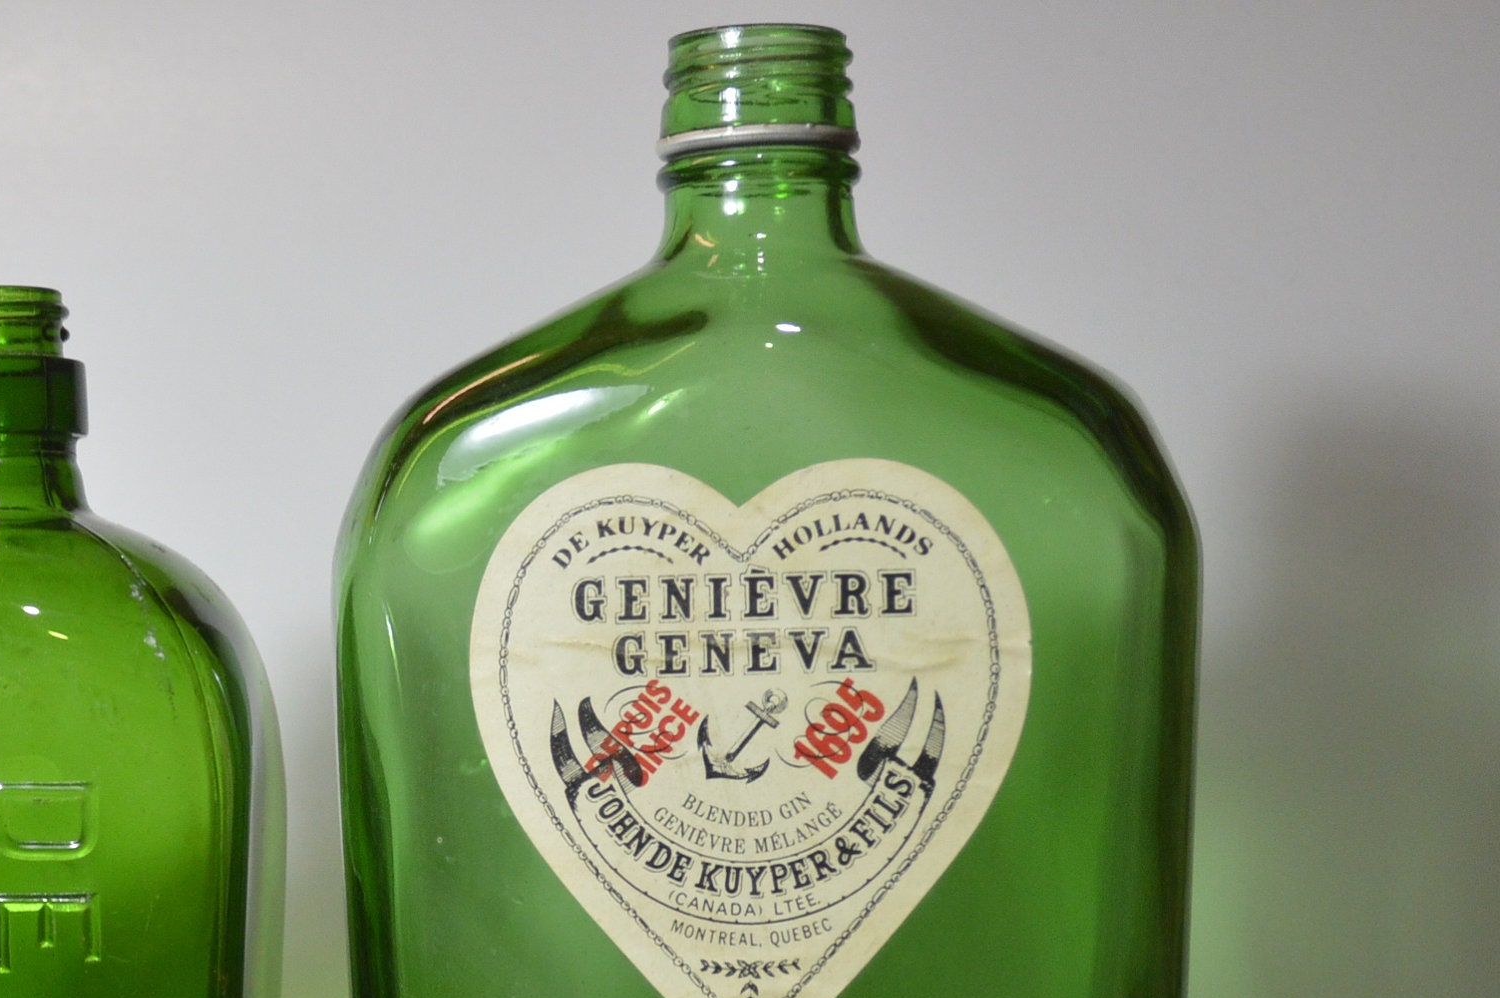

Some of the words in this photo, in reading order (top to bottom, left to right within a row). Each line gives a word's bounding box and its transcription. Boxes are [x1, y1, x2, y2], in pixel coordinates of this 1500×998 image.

[551, 532, 590, 569] DE
[599, 515, 711, 566] KUYPER
[771, 512, 934, 561] HOLLANDS
[572, 564, 915, 623] GENIÈVRE
[613, 628, 876, 676] GENEVA
[584, 679, 672, 783] DEPUIS
[794, 676, 886, 780] 1695
[587, 782, 654, 858] JOHN
[645, 841, 693, 883] DE
[694, 849, 838, 897] KUYPER
[835, 836, 862, 867] &
[849, 769, 914, 848] FILS
[653, 806, 746, 855] GENIÈVRE
[755, 800, 844, 855] MÉLANGÉ
[681, 793, 773, 828] BLENDED
[779, 791, 813, 820] GIN
[668, 890, 763, 917] (CANADA)
[769, 917, 833, 948] QUEBEC
